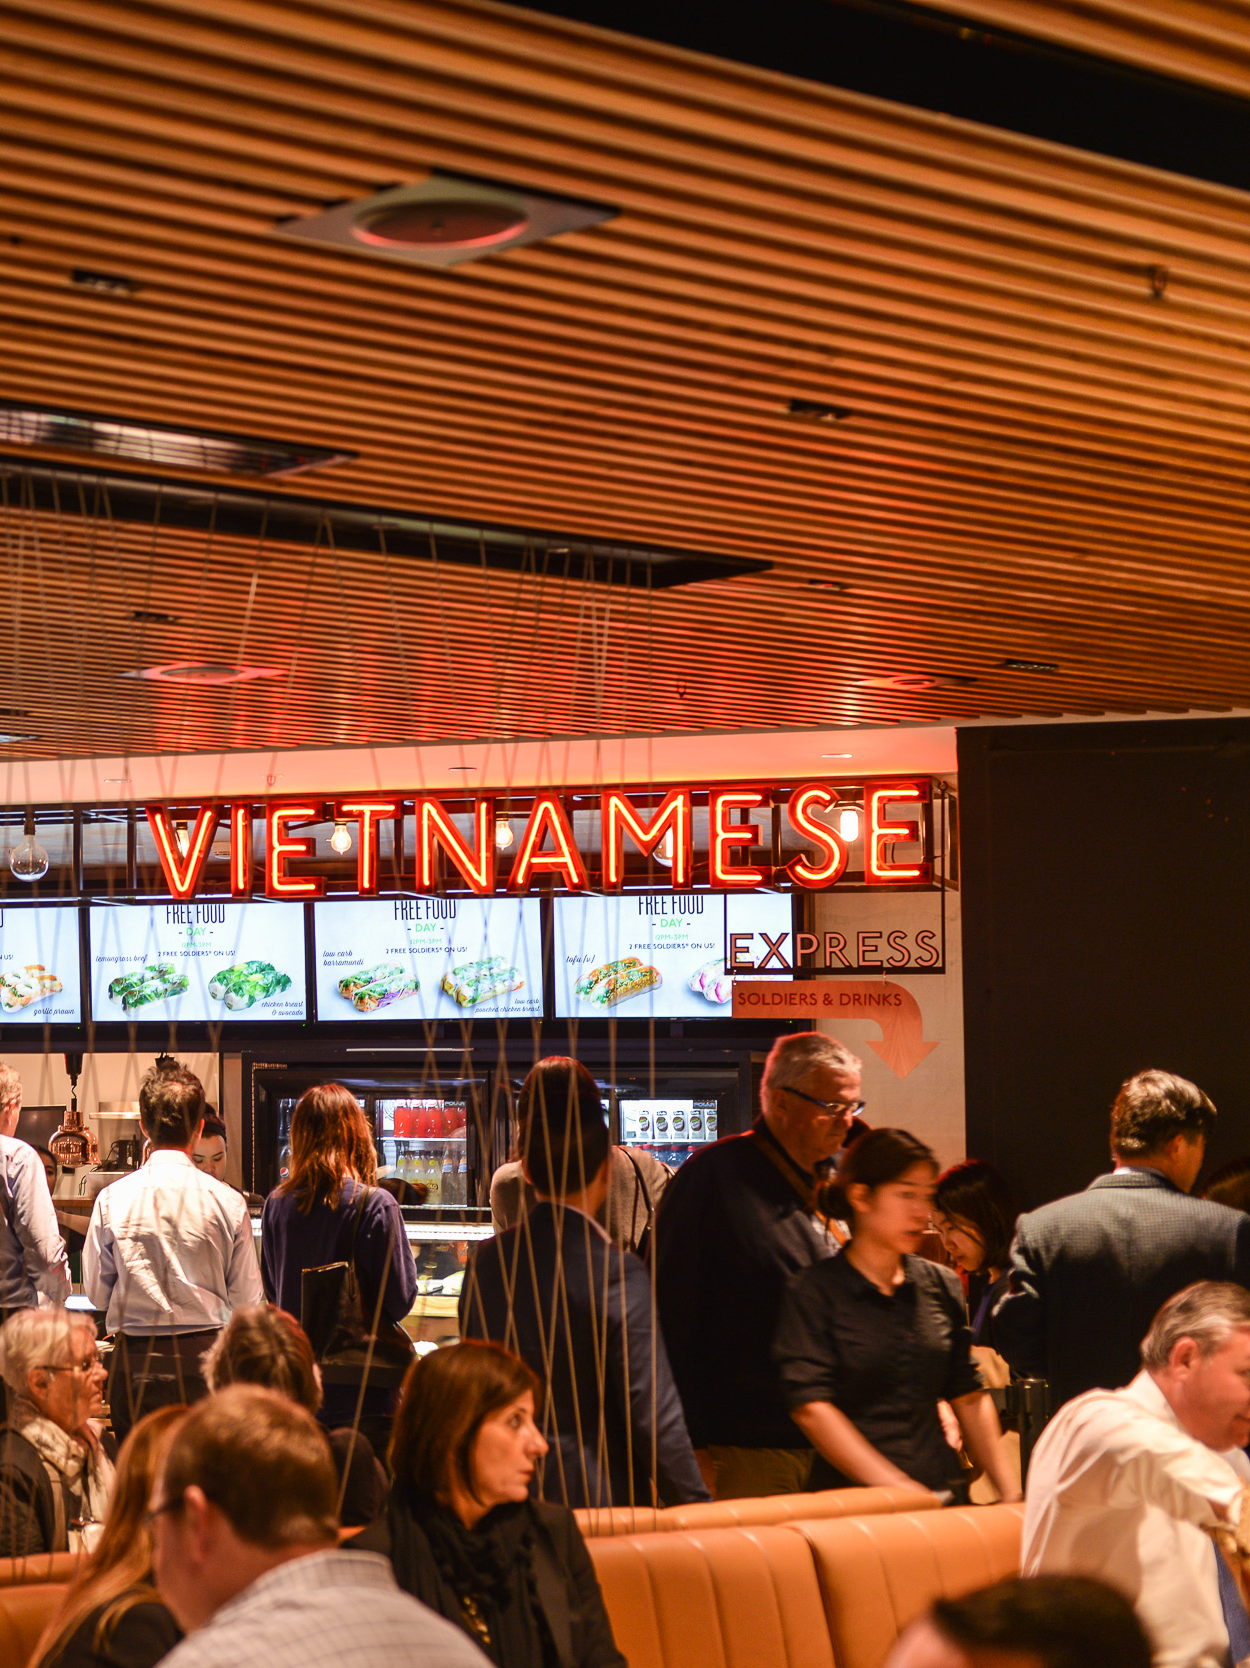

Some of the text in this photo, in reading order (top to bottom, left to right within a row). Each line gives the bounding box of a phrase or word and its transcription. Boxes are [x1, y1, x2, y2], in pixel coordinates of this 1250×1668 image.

[148, 782, 932, 899] VIETNAMESE
[415, 923, 437, 932] DAY
[660, 919, 683, 928] DAY
[186, 927, 206, 936] DAY
[729, 931, 940, 969] EXPRESS
[738, 992, 903, 1007] SOLDIERS & DRINKS
